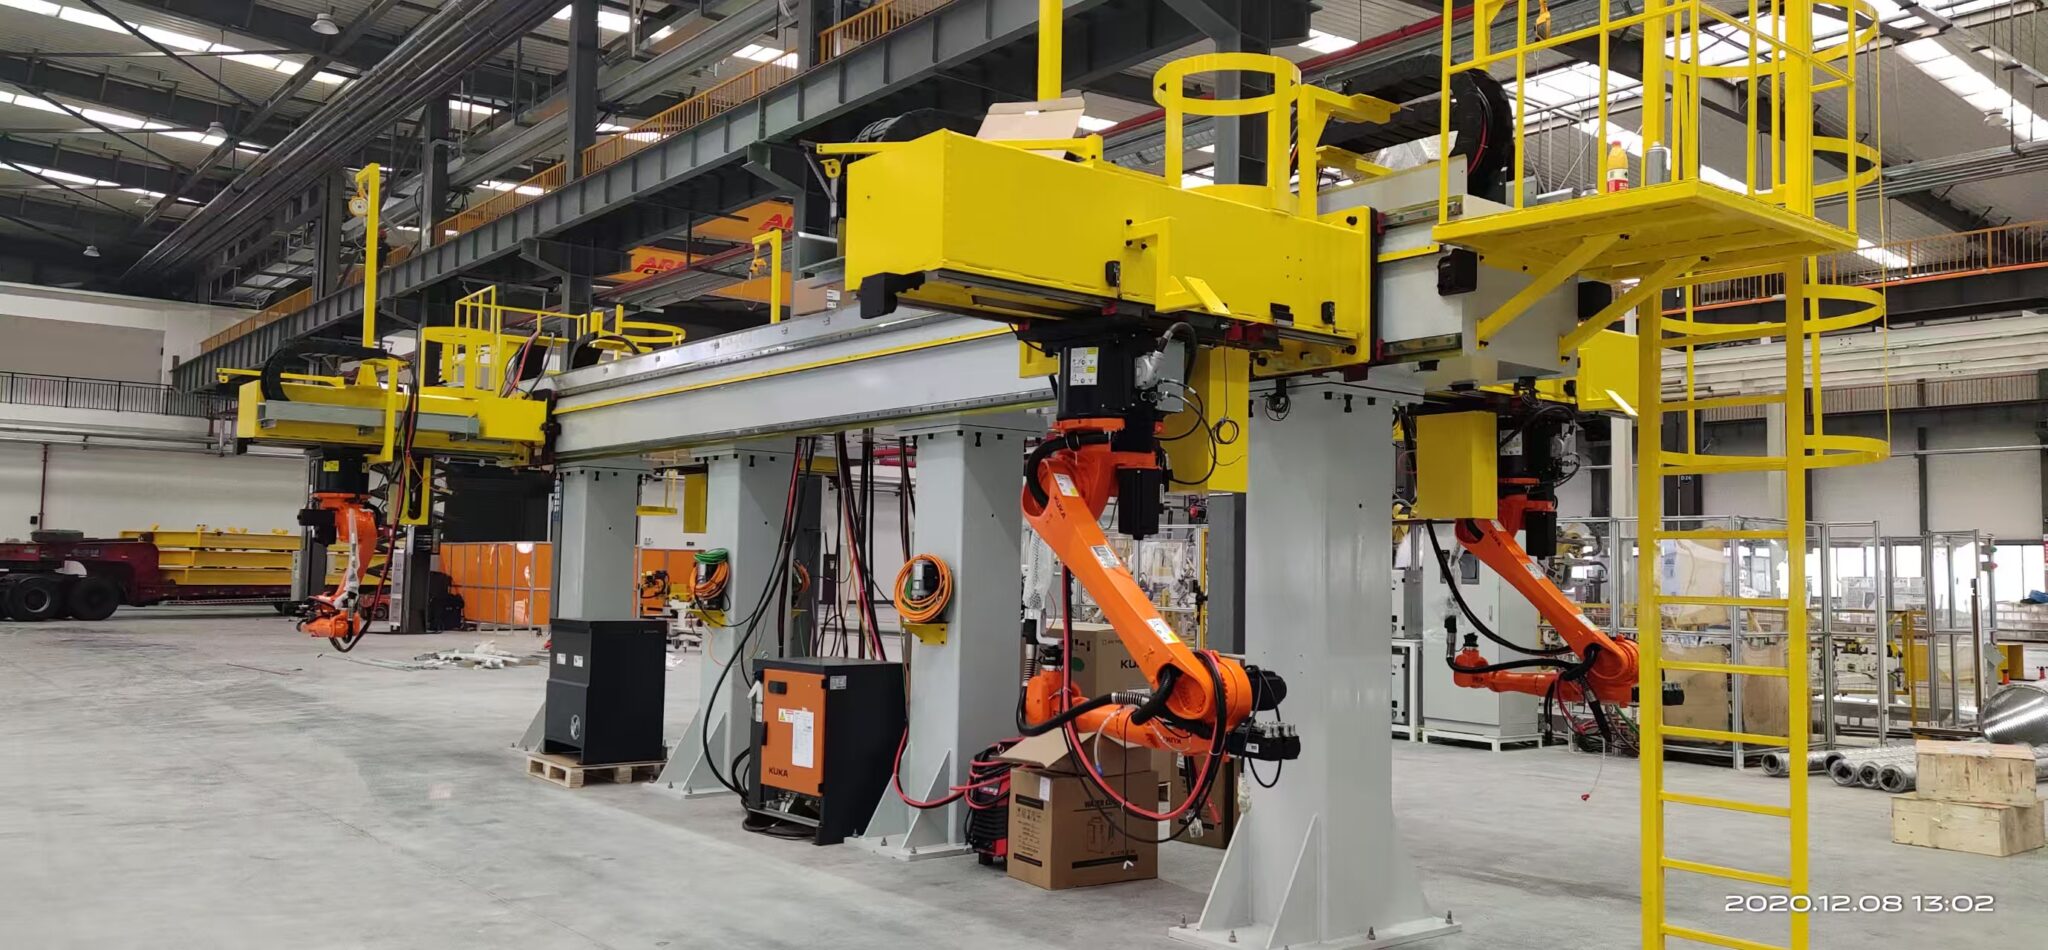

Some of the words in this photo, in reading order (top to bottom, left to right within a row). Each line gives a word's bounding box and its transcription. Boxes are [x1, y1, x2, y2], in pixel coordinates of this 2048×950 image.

[1054, 496, 1066, 520] KUKA
[1120, 659, 1140, 669] KU
[768, 766, 789, 778] KUKA
